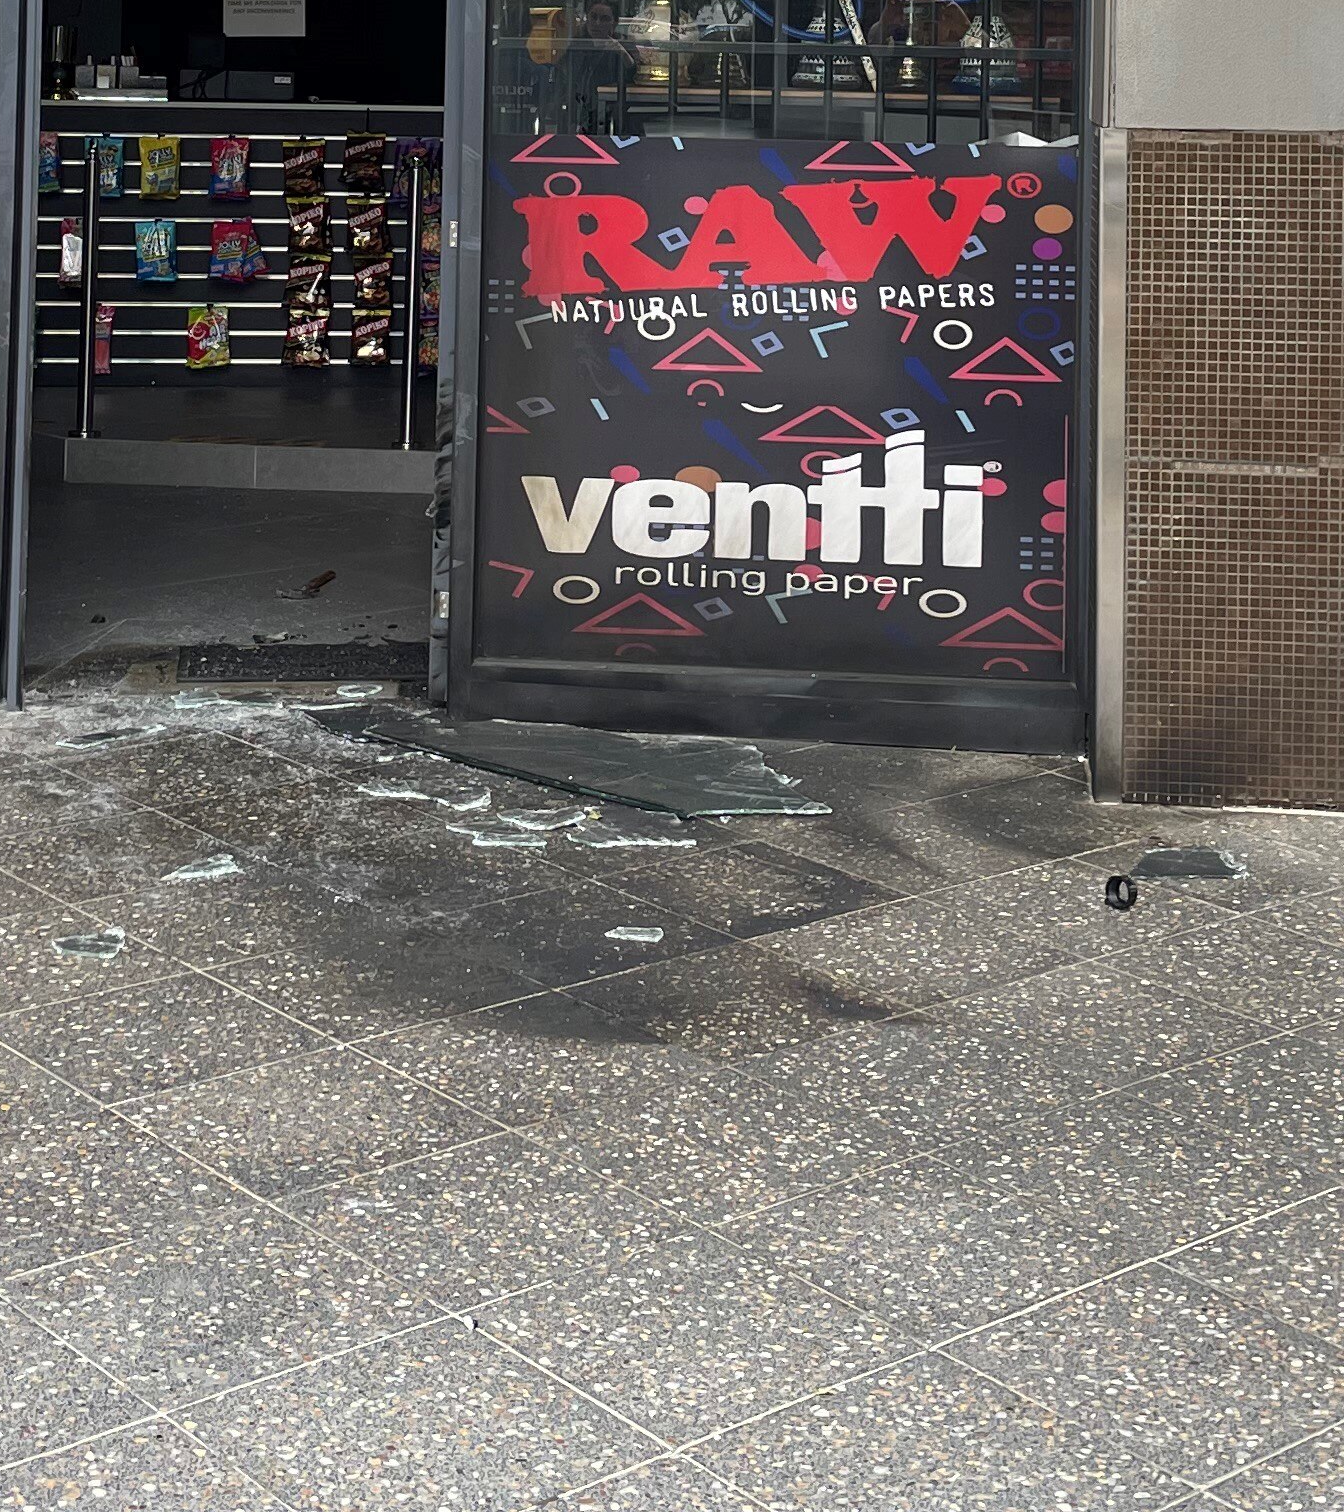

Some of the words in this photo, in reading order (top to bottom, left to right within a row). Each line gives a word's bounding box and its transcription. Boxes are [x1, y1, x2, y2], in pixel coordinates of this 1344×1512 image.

[514, 175, 1002, 297] RAW
[289, 263, 324, 278] KOPIKO
[733, 287, 858, 317] ROLLING
[879, 284, 996, 310] PAPERS
[355, 318, 389, 337] KOPIKO
[615, 563, 767, 596] rolling
[786, 571, 923, 599] paper
